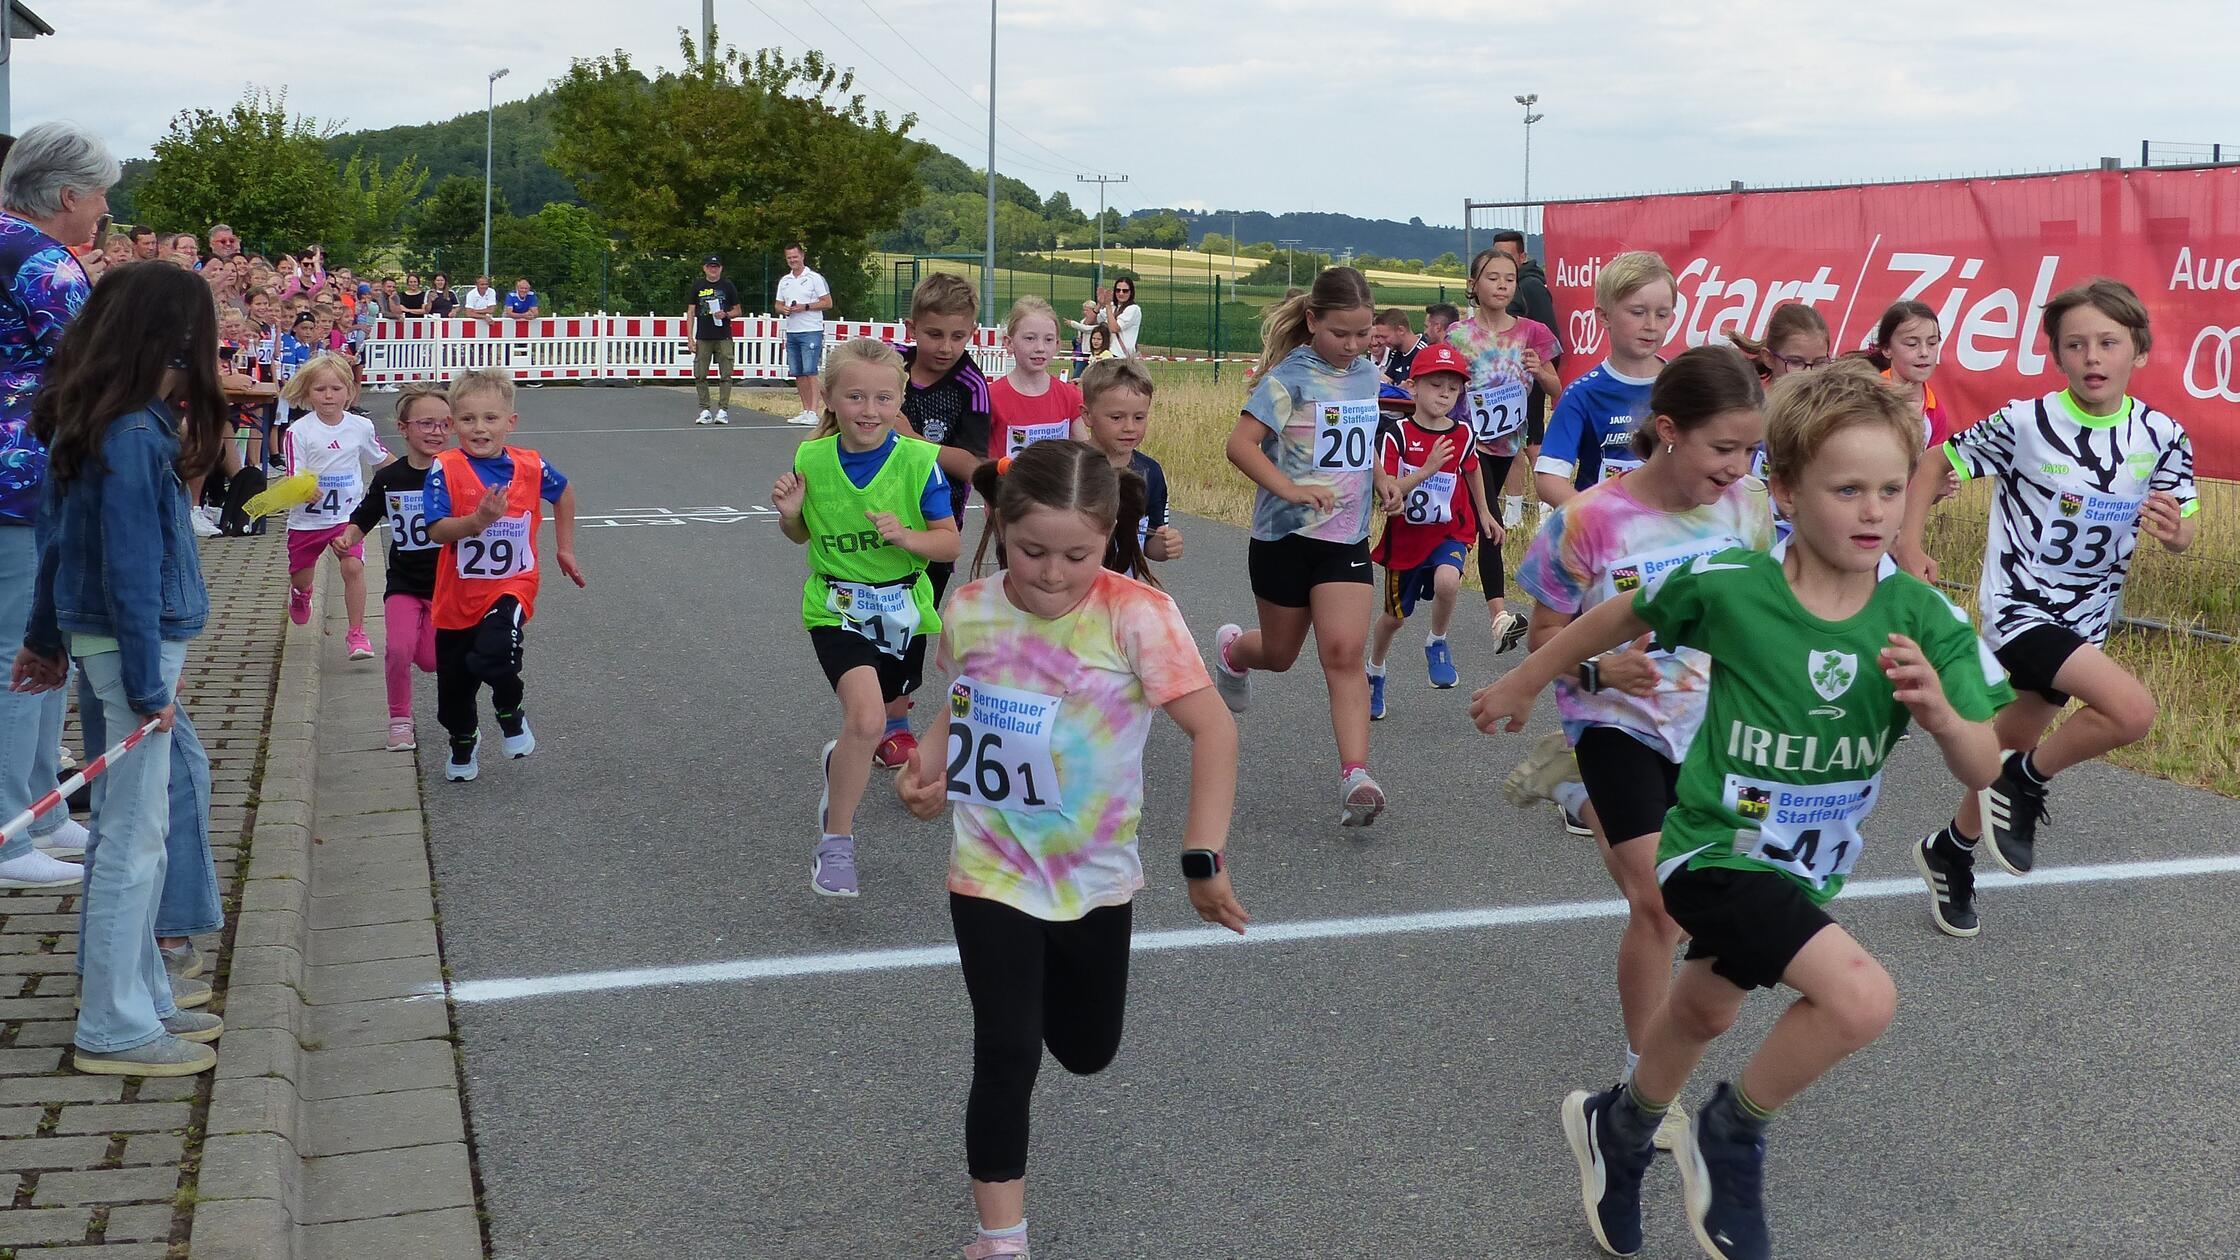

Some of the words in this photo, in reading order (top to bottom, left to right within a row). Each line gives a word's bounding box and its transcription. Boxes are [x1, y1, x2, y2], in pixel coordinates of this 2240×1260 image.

[1556, 257, 1600, 287] Audi
[1485, 384, 1520, 399] Berngauer
[1486, 390, 1522, 406] Staffellauf
[1342, 404, 1377, 415] Berngauer
[1476, 404, 1513, 437] 22
[1609, 415, 1633, 425] JAKO
[1319, 426, 1366, 468] 20
[2040, 463, 2070, 475] JAKO
[391, 512, 431, 548] 36
[2040, 518, 2113, 569] 33
[463, 539, 514, 576] 29
[973, 688, 1047, 718] Berngauer
[973, 706, 1043, 736] Staffellauf
[1727, 719, 1890, 773] IRELAN
[946, 722, 1011, 802] 26
[1017, 762, 1046, 806] 1
